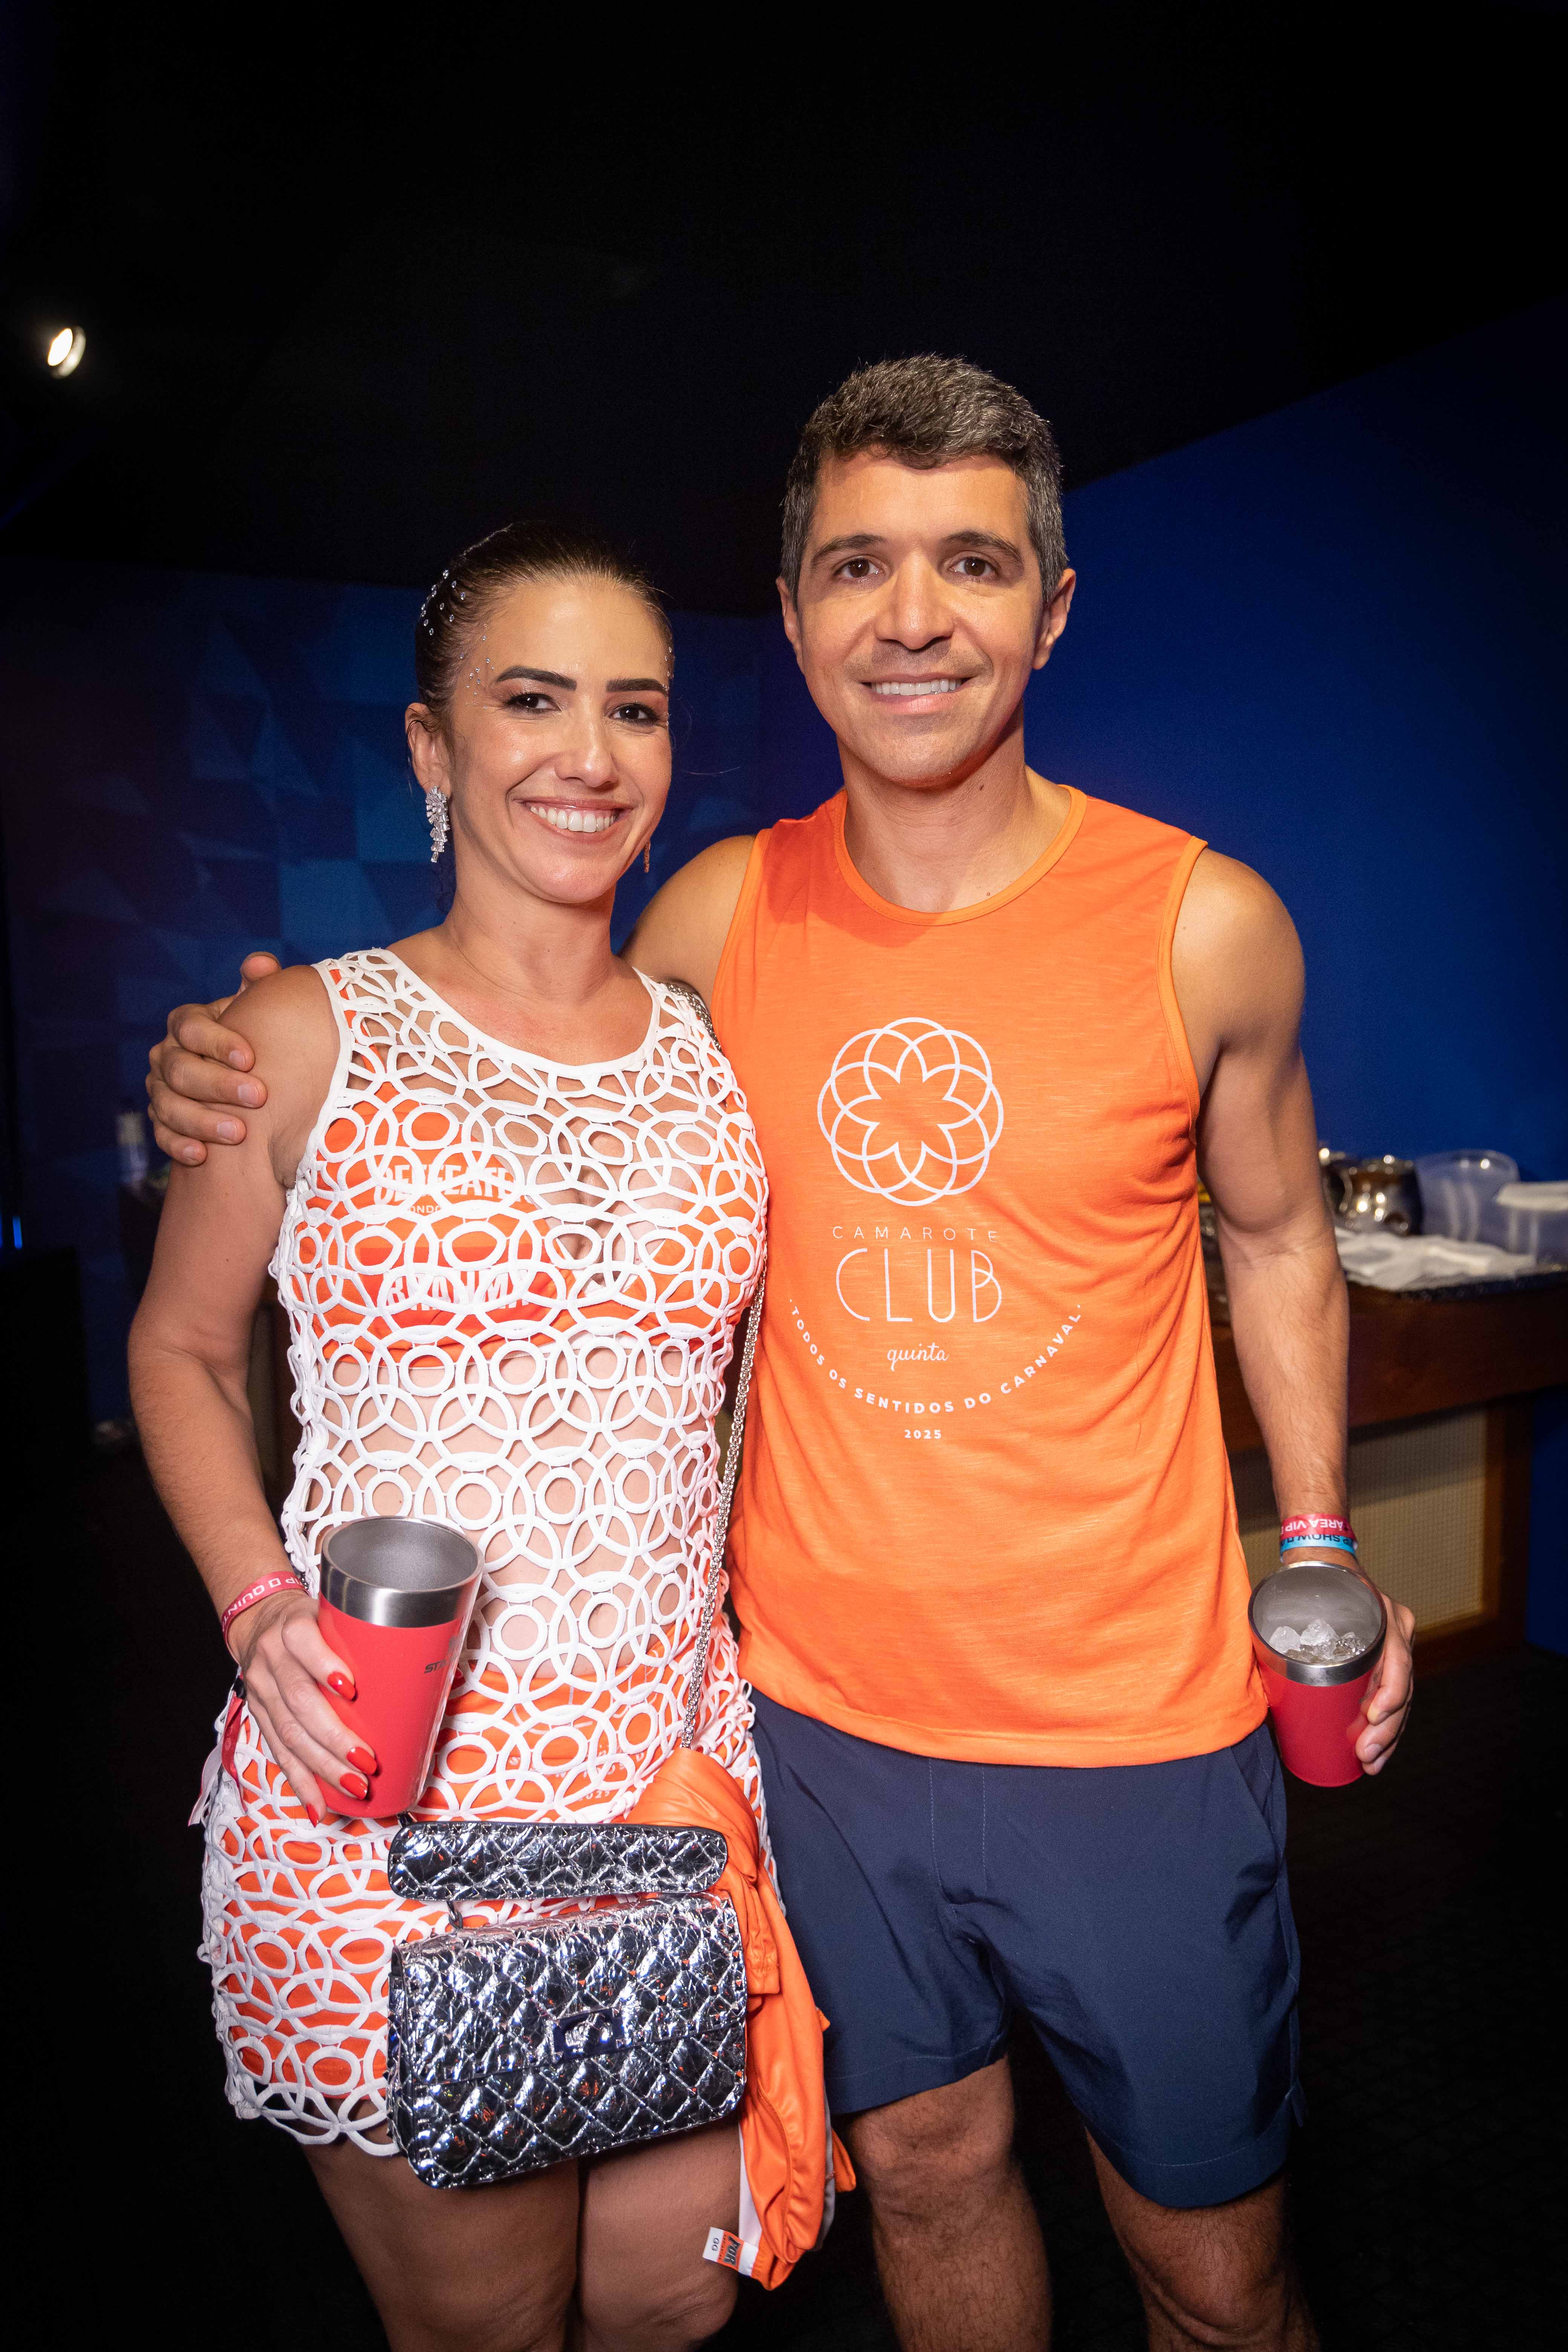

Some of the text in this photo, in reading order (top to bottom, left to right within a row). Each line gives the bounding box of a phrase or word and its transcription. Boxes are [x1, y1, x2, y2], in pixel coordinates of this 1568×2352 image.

[832, 1226, 997, 1242] CAMAROTE
[835, 1248, 1002, 1323] CLUB
[887, 1342, 950, 1372] quinta
[829, 1369, 847, 1389] OS
[854, 1387, 954, 1414] SENTIDOS
[963, 1392, 992, 1409] DO
[904, 1429, 942, 1440] 2025
[1285, 1521, 1307, 1532] VIP
